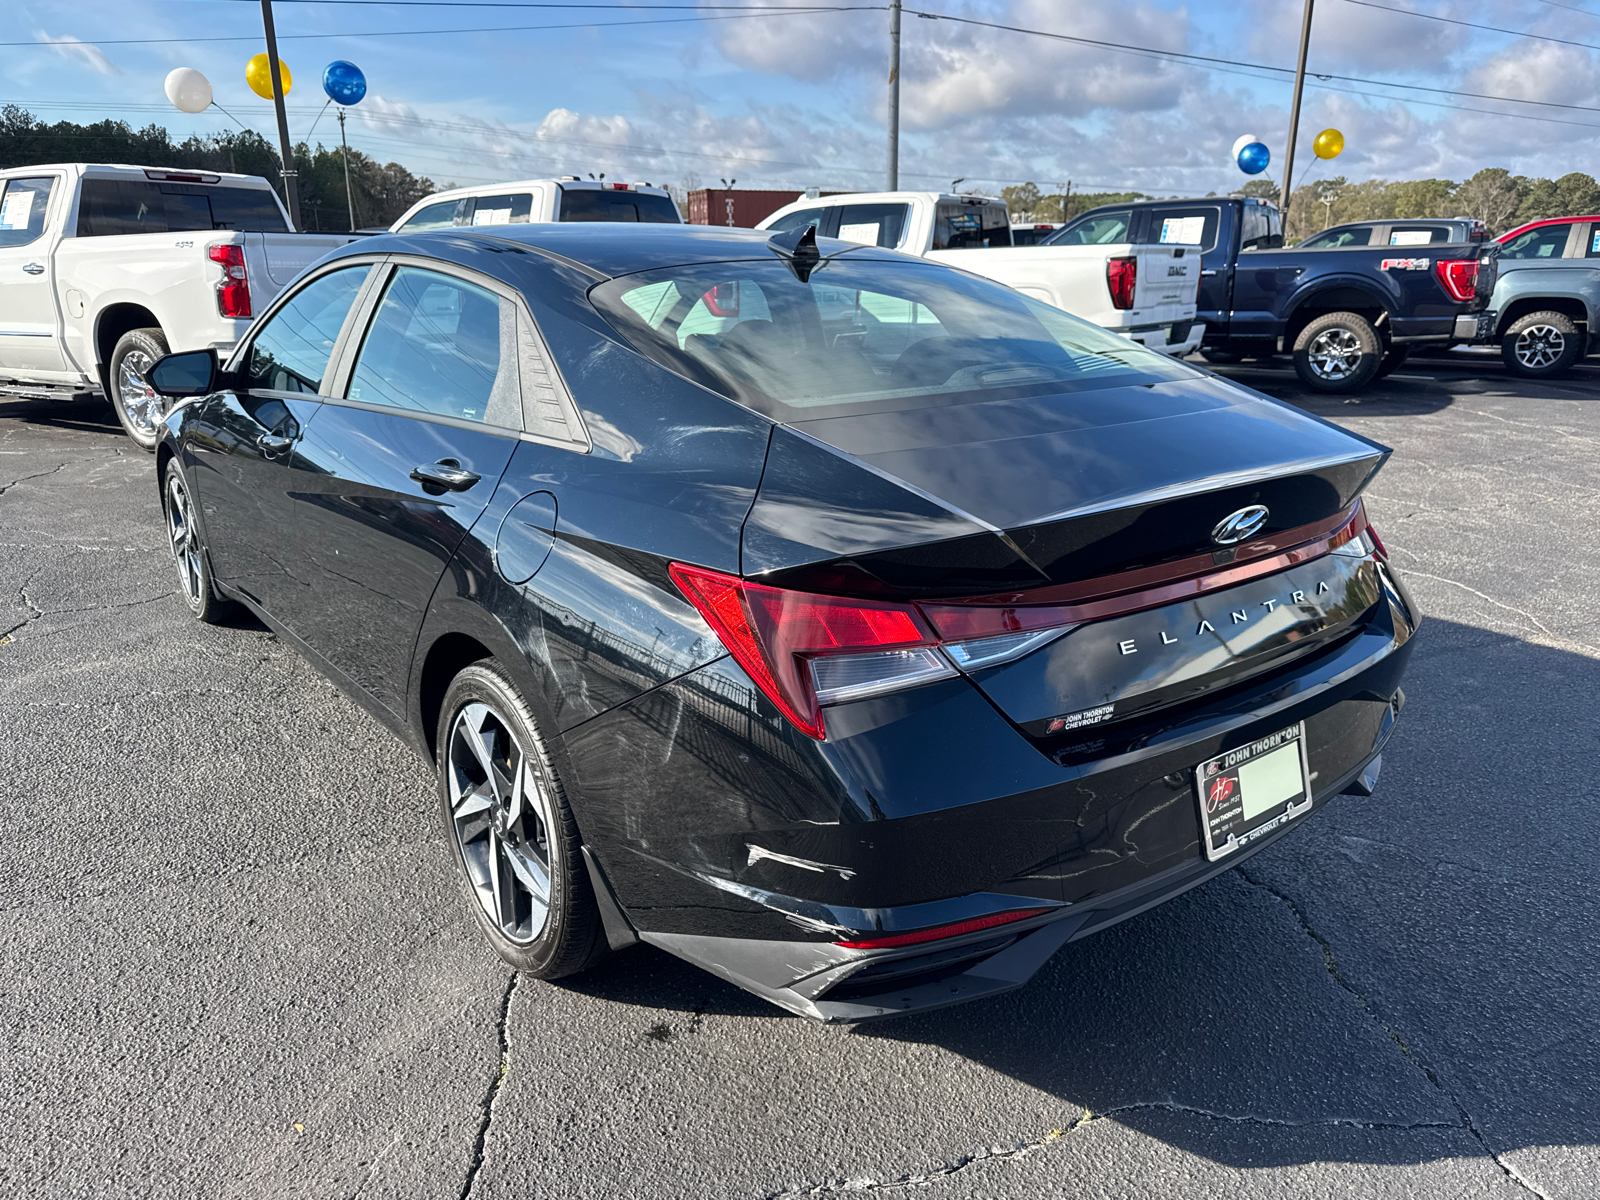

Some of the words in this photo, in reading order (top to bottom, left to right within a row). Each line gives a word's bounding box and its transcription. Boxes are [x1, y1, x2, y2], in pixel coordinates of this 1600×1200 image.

[1167, 266, 1187, 277] GMC
[1381, 258, 1430, 271] FX4
[1119, 581, 1329, 655] ELANTRA
[1065, 716, 1102, 730] CHEVROLET
[1066, 713, 1082, 723] JOHN
[1083, 704, 1115, 717] THORNTON
[1225, 748, 1250, 768] JOHN
[1249, 820, 1280, 840] CHEVROLET
